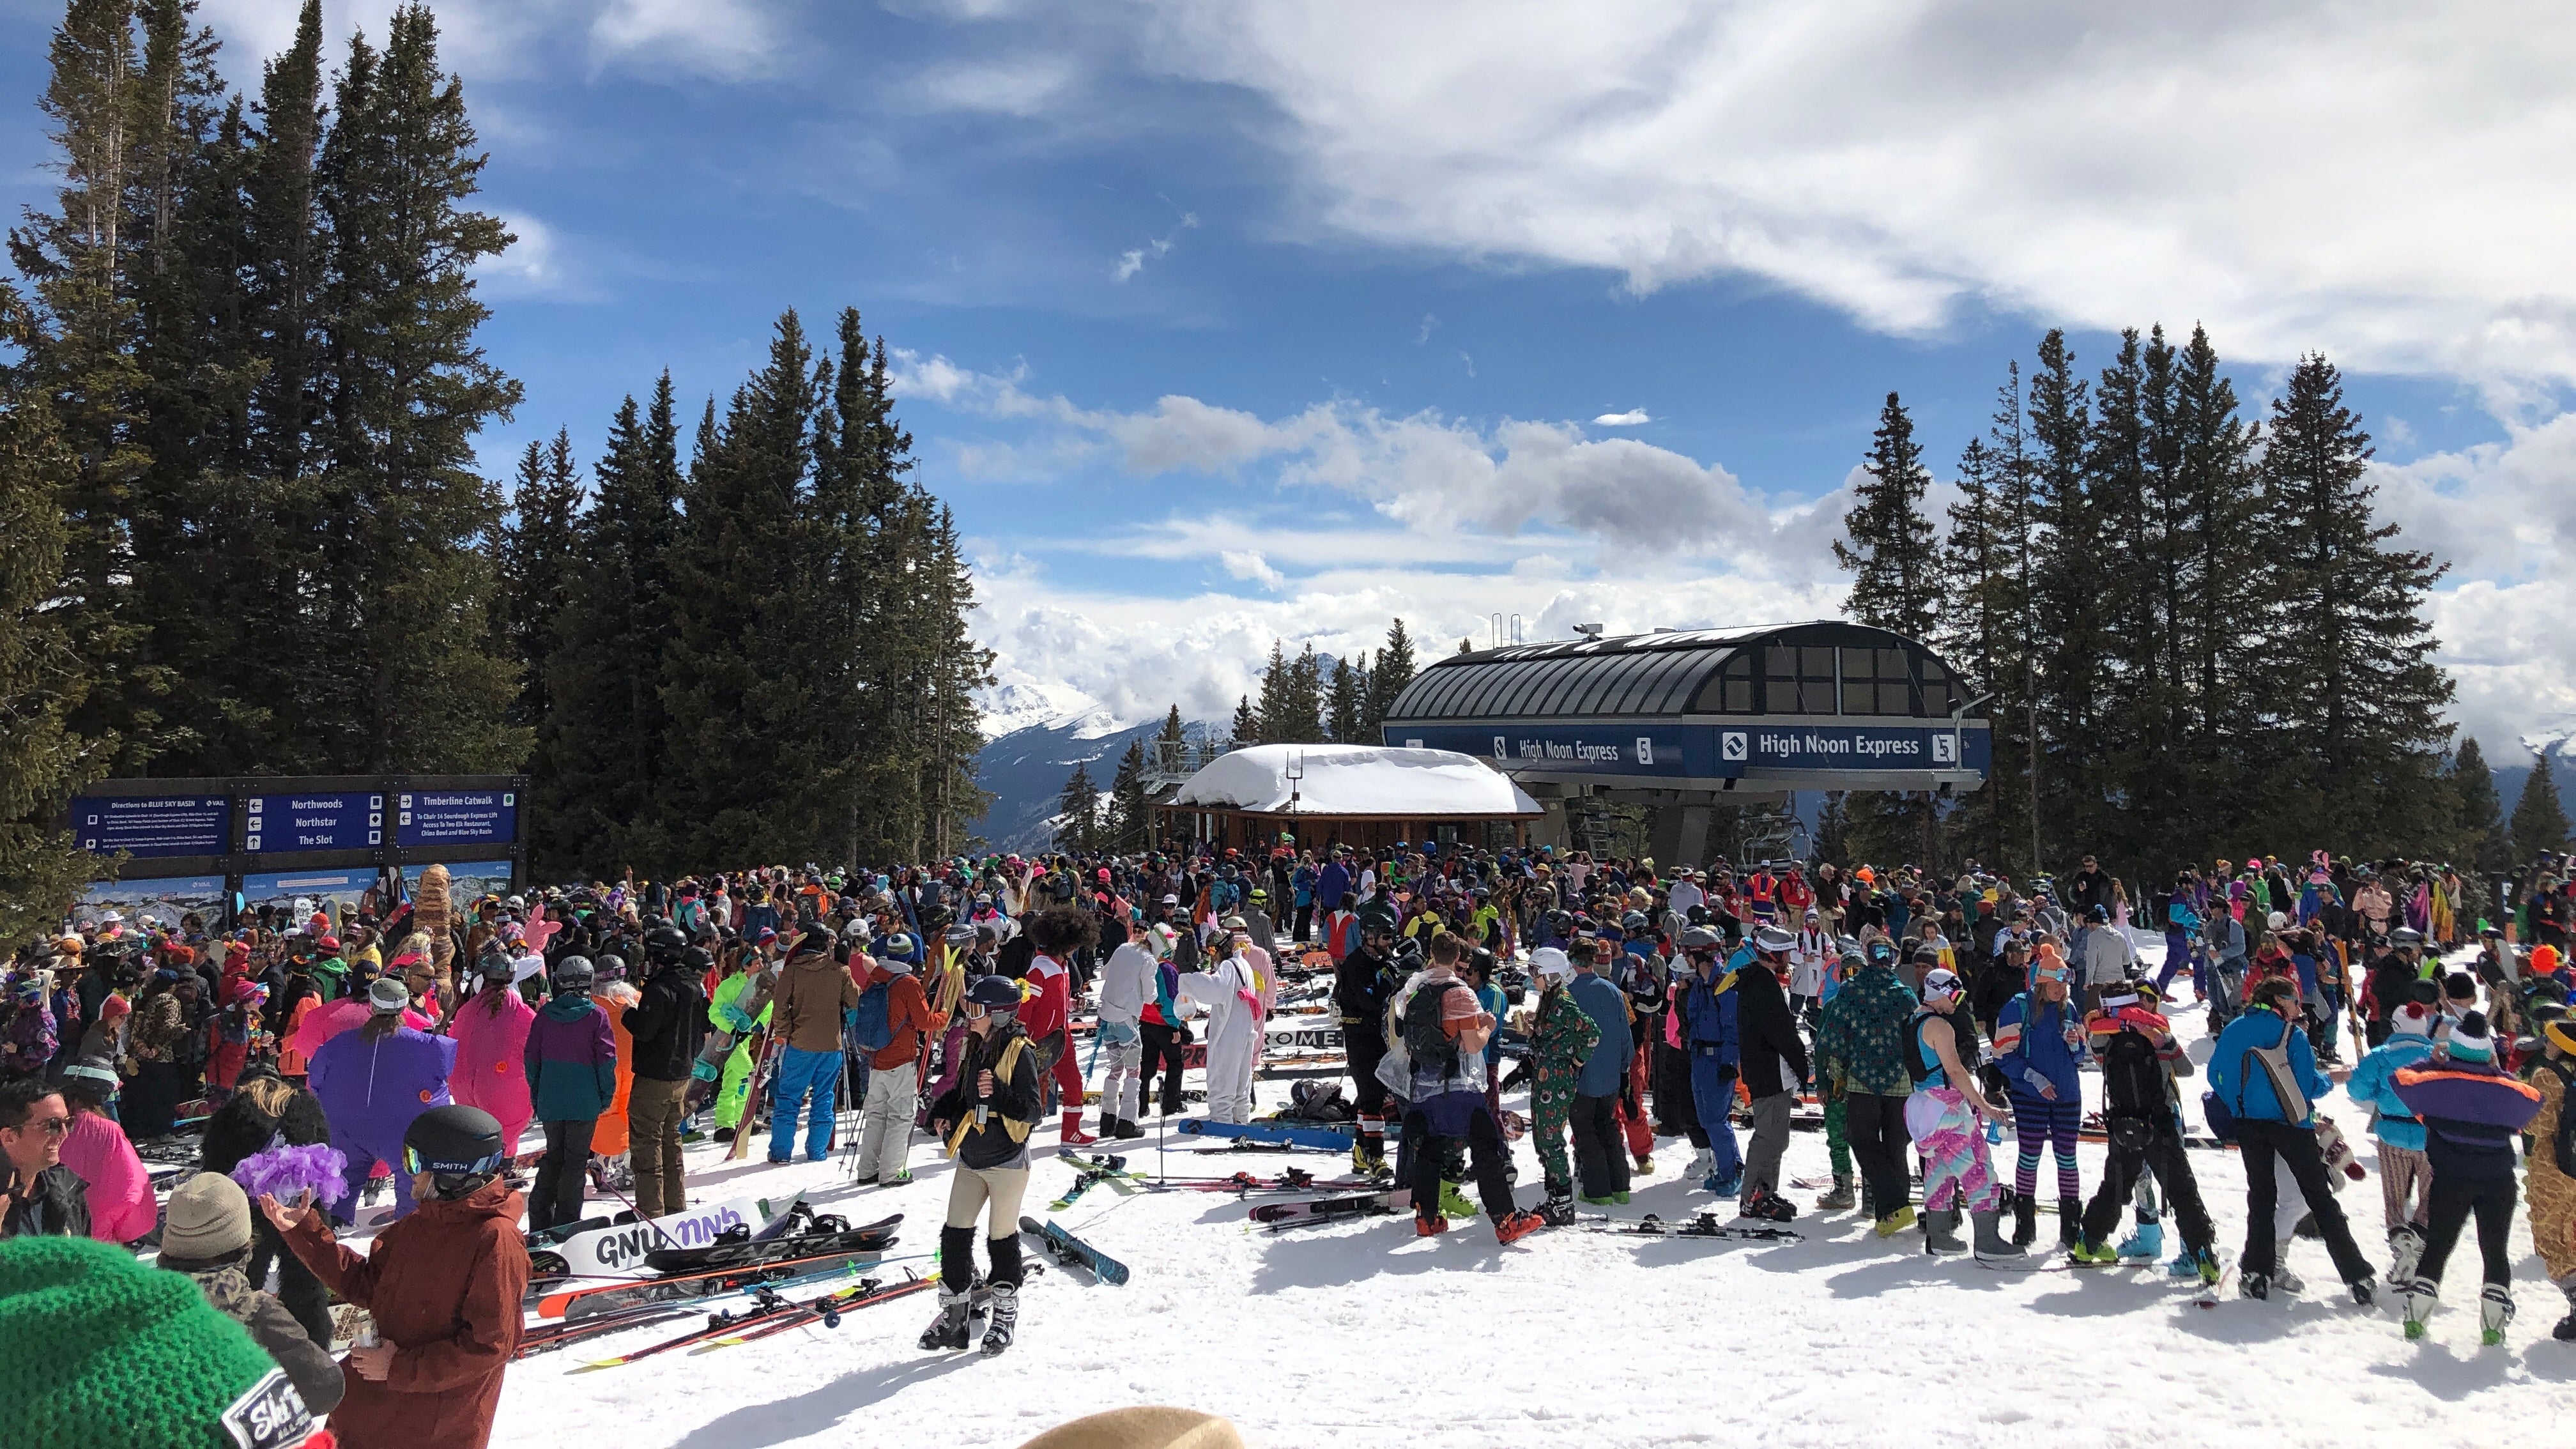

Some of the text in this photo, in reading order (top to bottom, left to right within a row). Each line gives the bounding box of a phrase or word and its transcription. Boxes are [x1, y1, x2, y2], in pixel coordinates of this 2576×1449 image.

[1639, 740, 1648, 761] 5
[1760, 734, 1919, 758] High Noon Express
[1939, 739, 1950, 758] 5
[1519, 740, 1619, 764] High Noon Express
[291, 799, 343, 809] Northwoods
[424, 795, 493, 806] Timberline Catwalk
[443, 812, 470, 820] Sourdough
[470, 812, 488, 820] Express
[295, 817, 337, 827] Northstar
[299, 835, 333, 845] The Slot
[433, 1162, 468, 1170] SMITH
[595, 1225, 669, 1269] GNU
